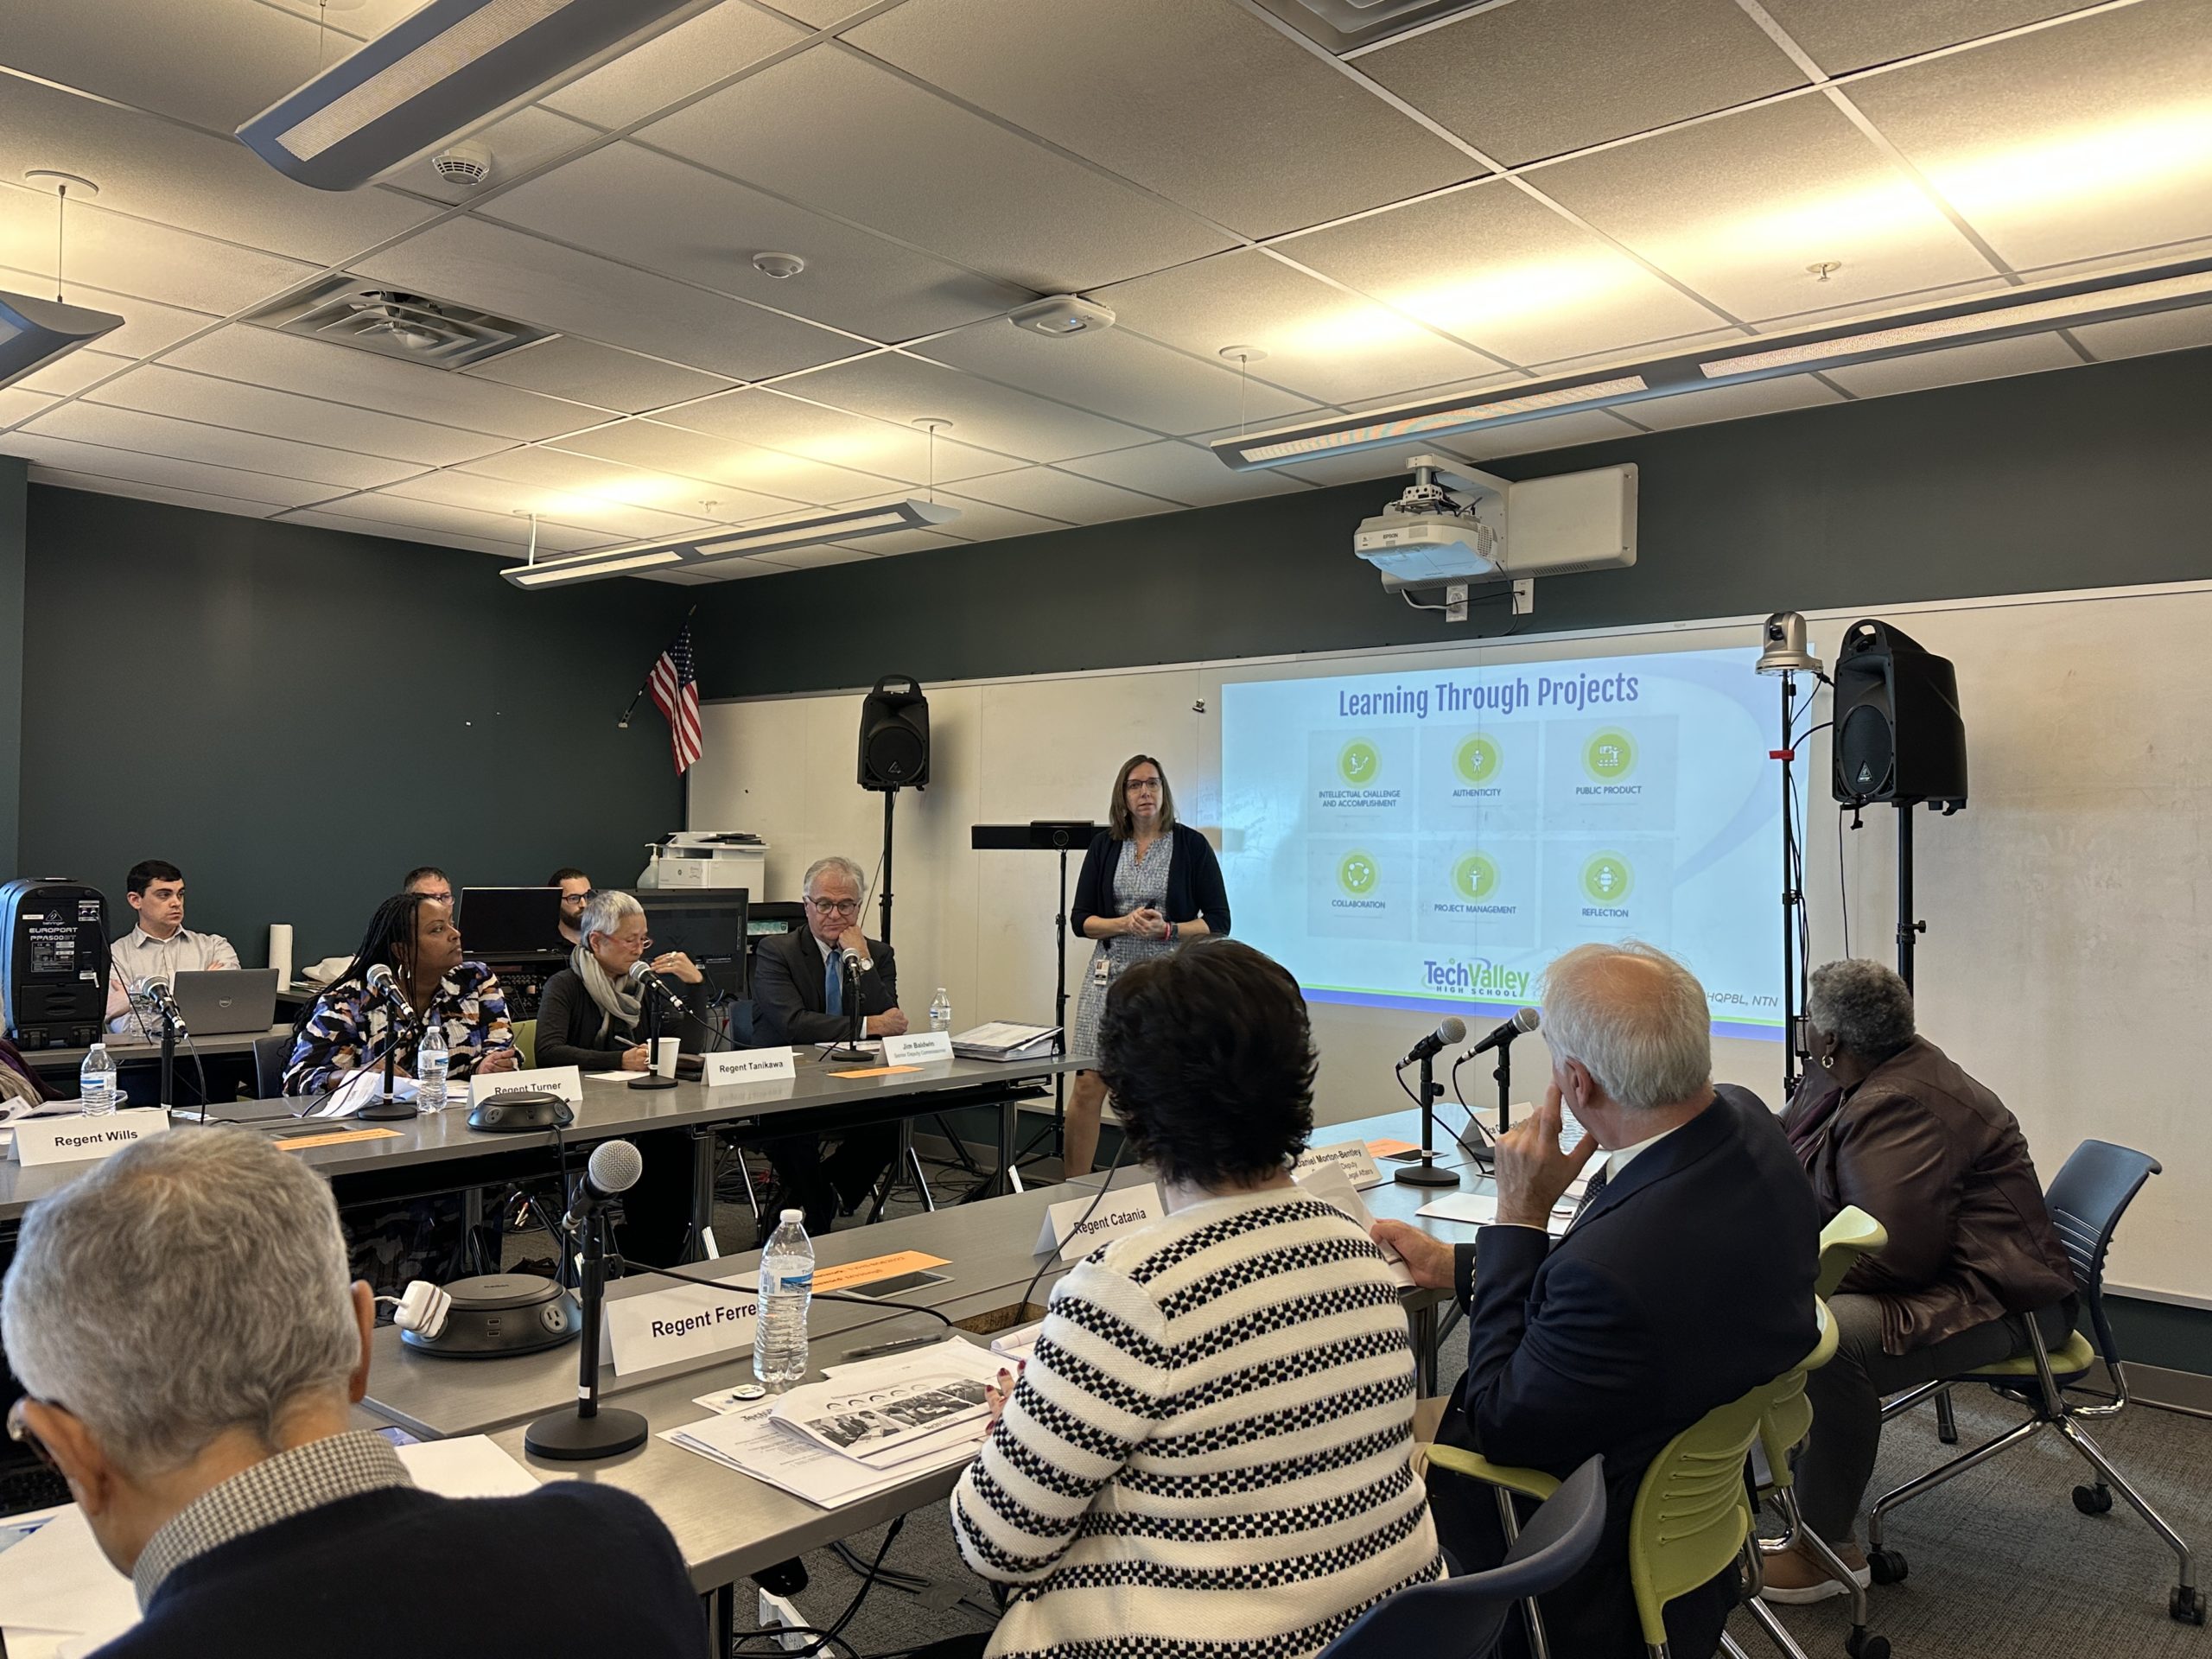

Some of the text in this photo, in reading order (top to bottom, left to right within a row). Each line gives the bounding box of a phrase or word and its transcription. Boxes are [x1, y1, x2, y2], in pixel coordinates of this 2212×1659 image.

[1339, 672, 1639, 719] Learning Through Projects
[1363, 790, 1402, 798] CHALLENGE
[1452, 788, 1502, 797] AUTHENTICITY
[1575, 785, 1643, 795] PUBLIC PRODUCT
[1332, 899, 1386, 909] COLLABORATION
[1433, 904, 1516, 914] PROJECT MANAGEMENT
[1581, 907, 1629, 918] REFLECTION
[1471, 988, 1517, 997] SCHOOL
[1752, 995, 1778, 1007] NTN
[913, 1040, 935, 1049] Baldwin
[719, 1061, 784, 1074] Regent Tanikawa
[531, 1082, 562, 1092] Turner
[54, 1129, 138, 1147] Regent Wills
[1316, 1148, 1362, 1163] Morton-Bentley
[1073, 1208, 1147, 1235] Regent Catania
[652, 1303, 759, 1338] Regent Ferre
